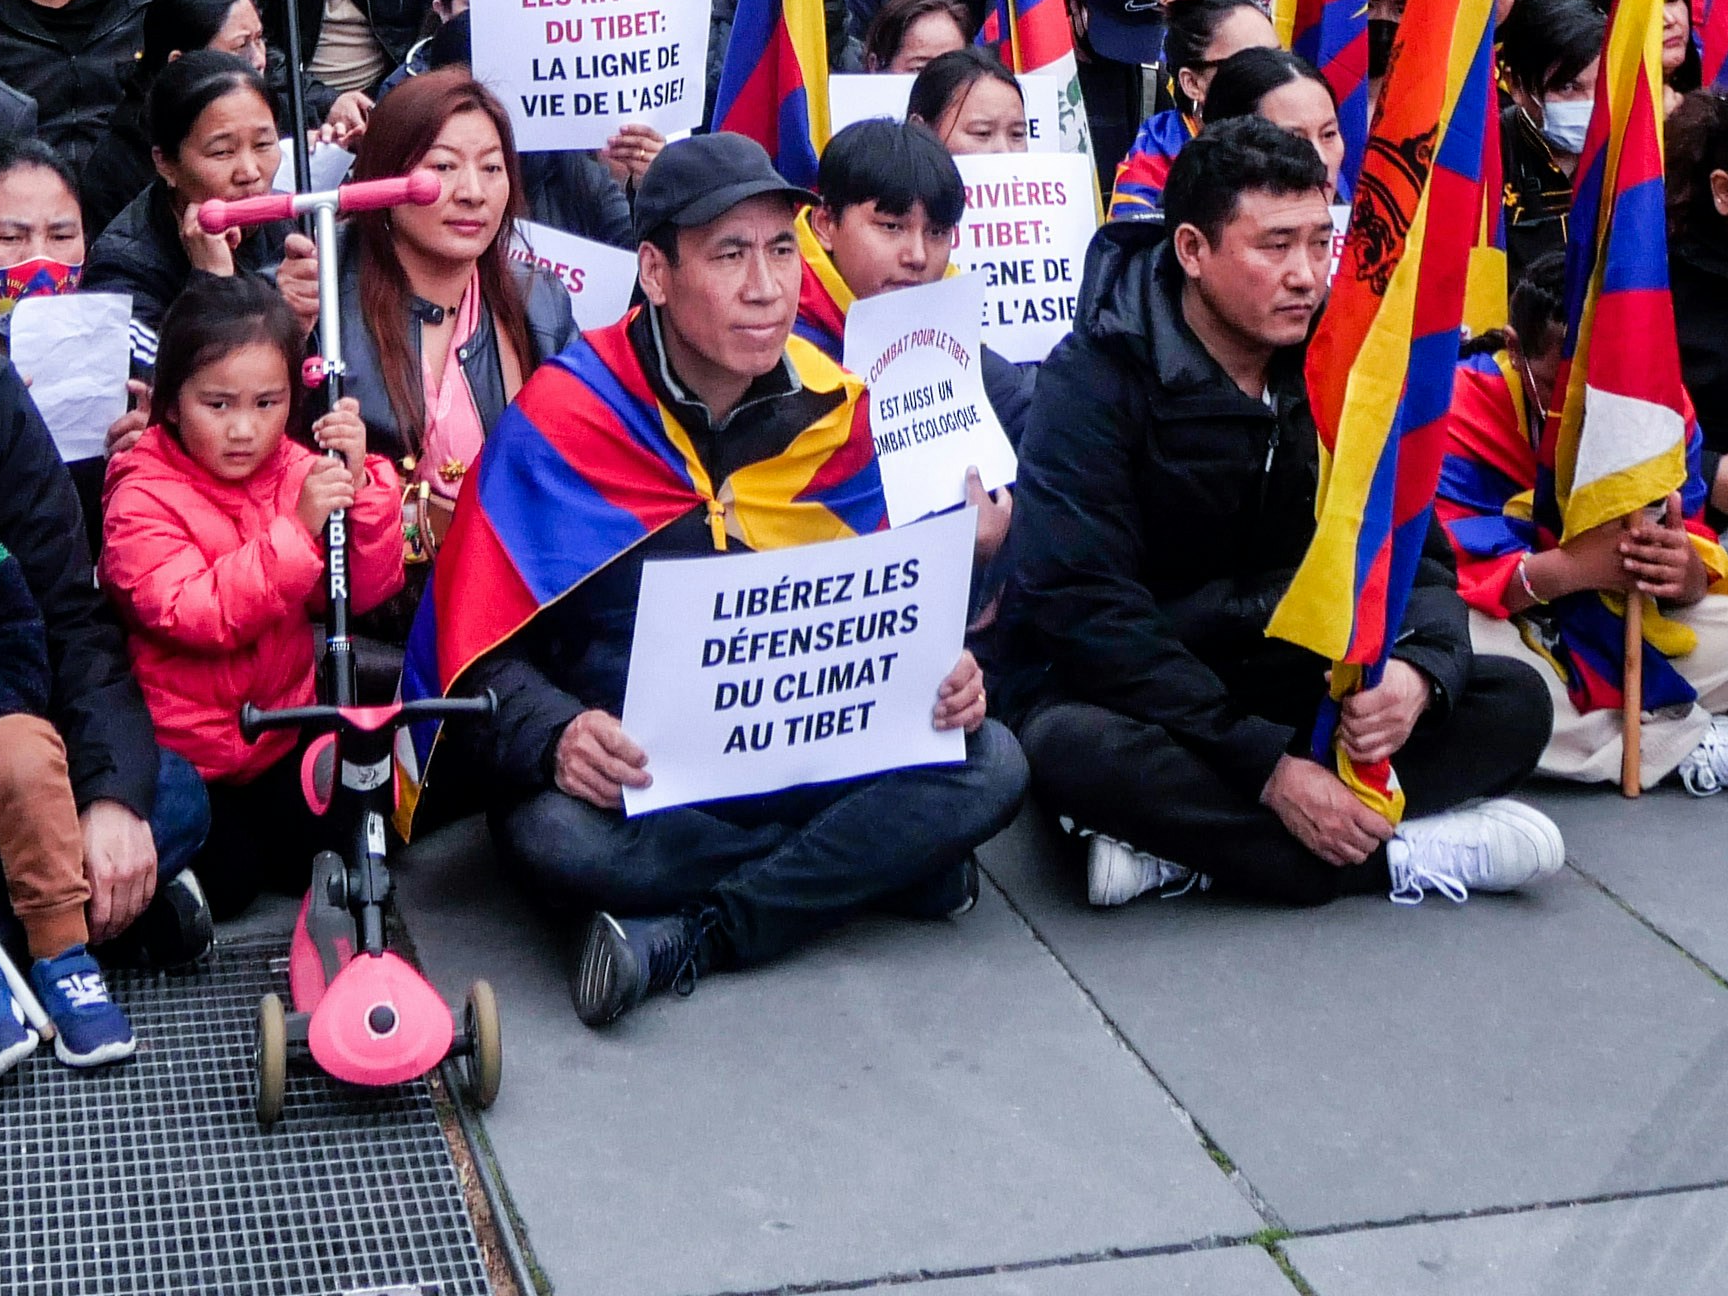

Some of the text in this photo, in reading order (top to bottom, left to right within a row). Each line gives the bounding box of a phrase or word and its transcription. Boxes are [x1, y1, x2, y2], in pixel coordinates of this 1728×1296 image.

[546, 10, 666, 44] DU TIBET:
[532, 43, 680, 81] LA LIGNE DE
[521, 77, 685, 118] VIE DE L'ASIE!
[964, 175, 1067, 209] RIVIÈRES
[969, 220, 1051, 249] TIBET:
[970, 258, 1072, 287] GNE DE
[870, 328, 971, 384] COMBAT POUR LE TIBET
[880, 378, 954, 421] EST AUSSI UN
[873, 404, 981, 457] OMBAT ÉCOLOGIQUE
[713, 558, 920, 621] LIBÉREZ LES
[701, 604, 919, 668] DÉFENSEURS
[714, 652, 898, 712] DU CLIMAT
[723, 700, 876, 754] AU TIBET
